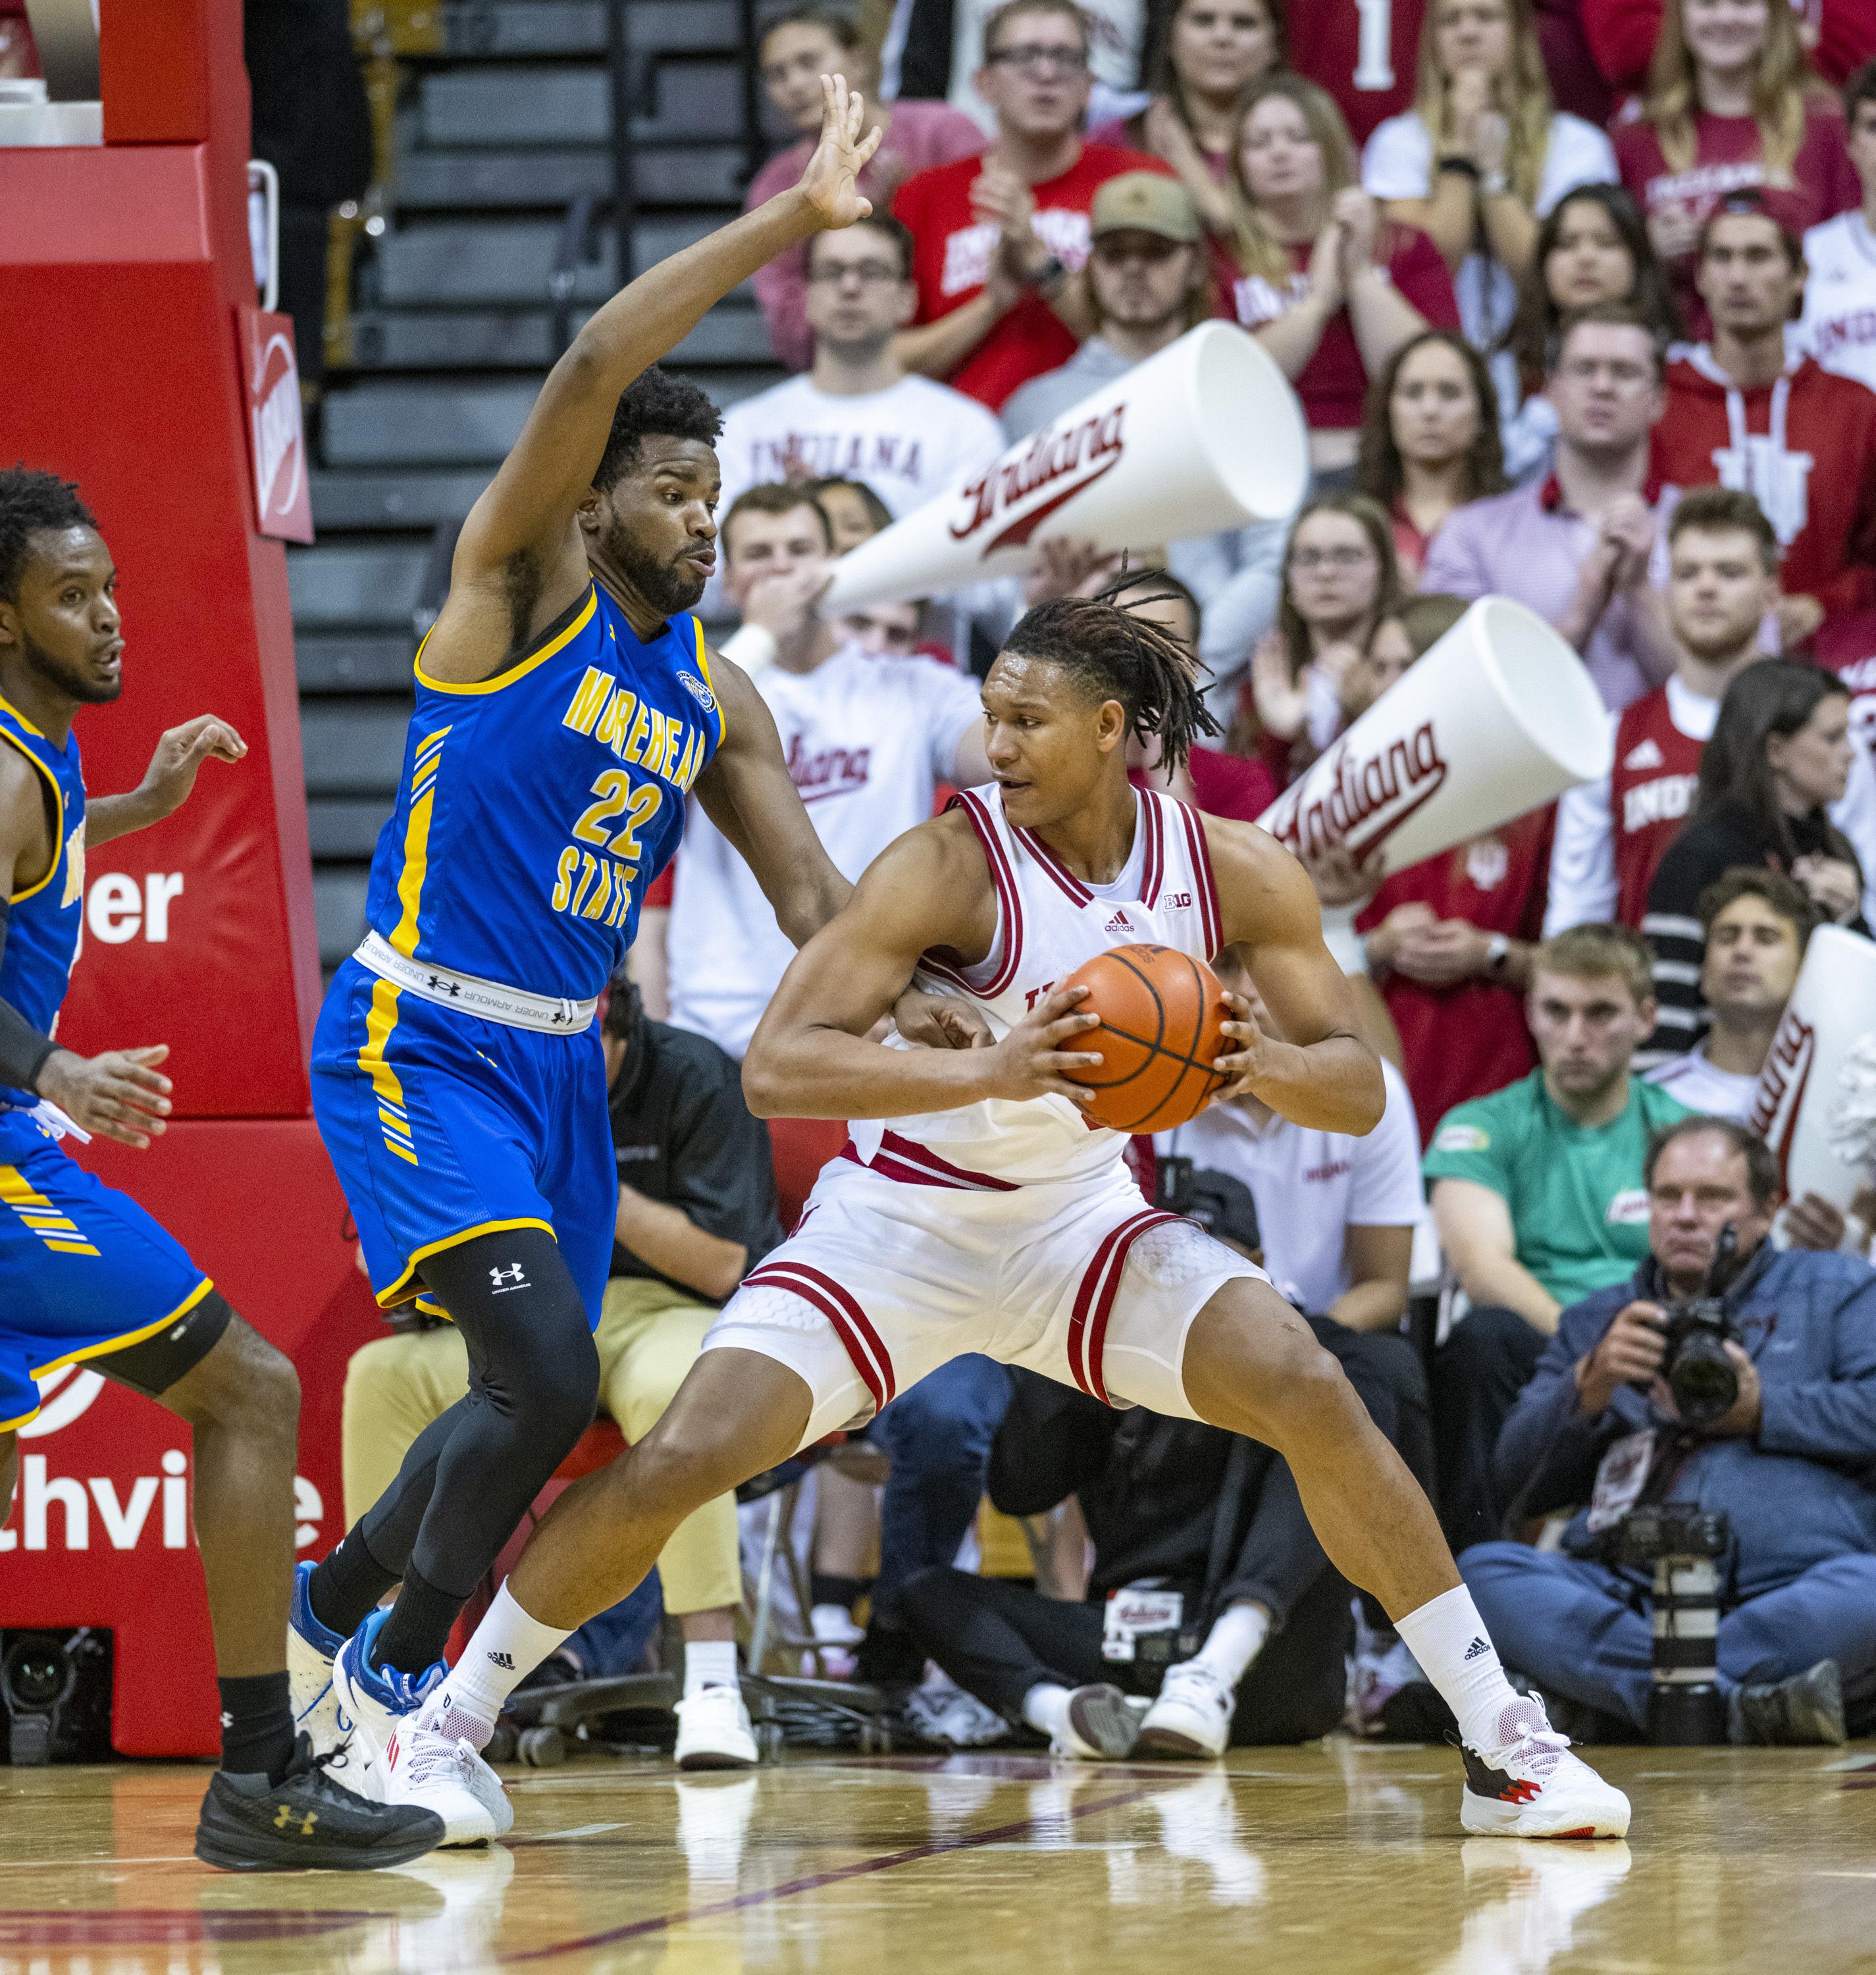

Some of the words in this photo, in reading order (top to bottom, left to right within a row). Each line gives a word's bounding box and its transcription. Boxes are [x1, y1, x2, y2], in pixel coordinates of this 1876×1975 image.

[572, 769, 663, 861] 22
[552, 845, 638, 928] STATE
[87, 872, 184, 944] er
[393, 957, 425, 982] UNDER
[464, 991, 511, 1011] ARMOUR
[515, 1004, 550, 1020] UNDER
[509, 1282, 531, 1291] ARMOUR
[487, 1652, 515, 1670] adidas
[1465, 1645, 1490, 1660] adidas
